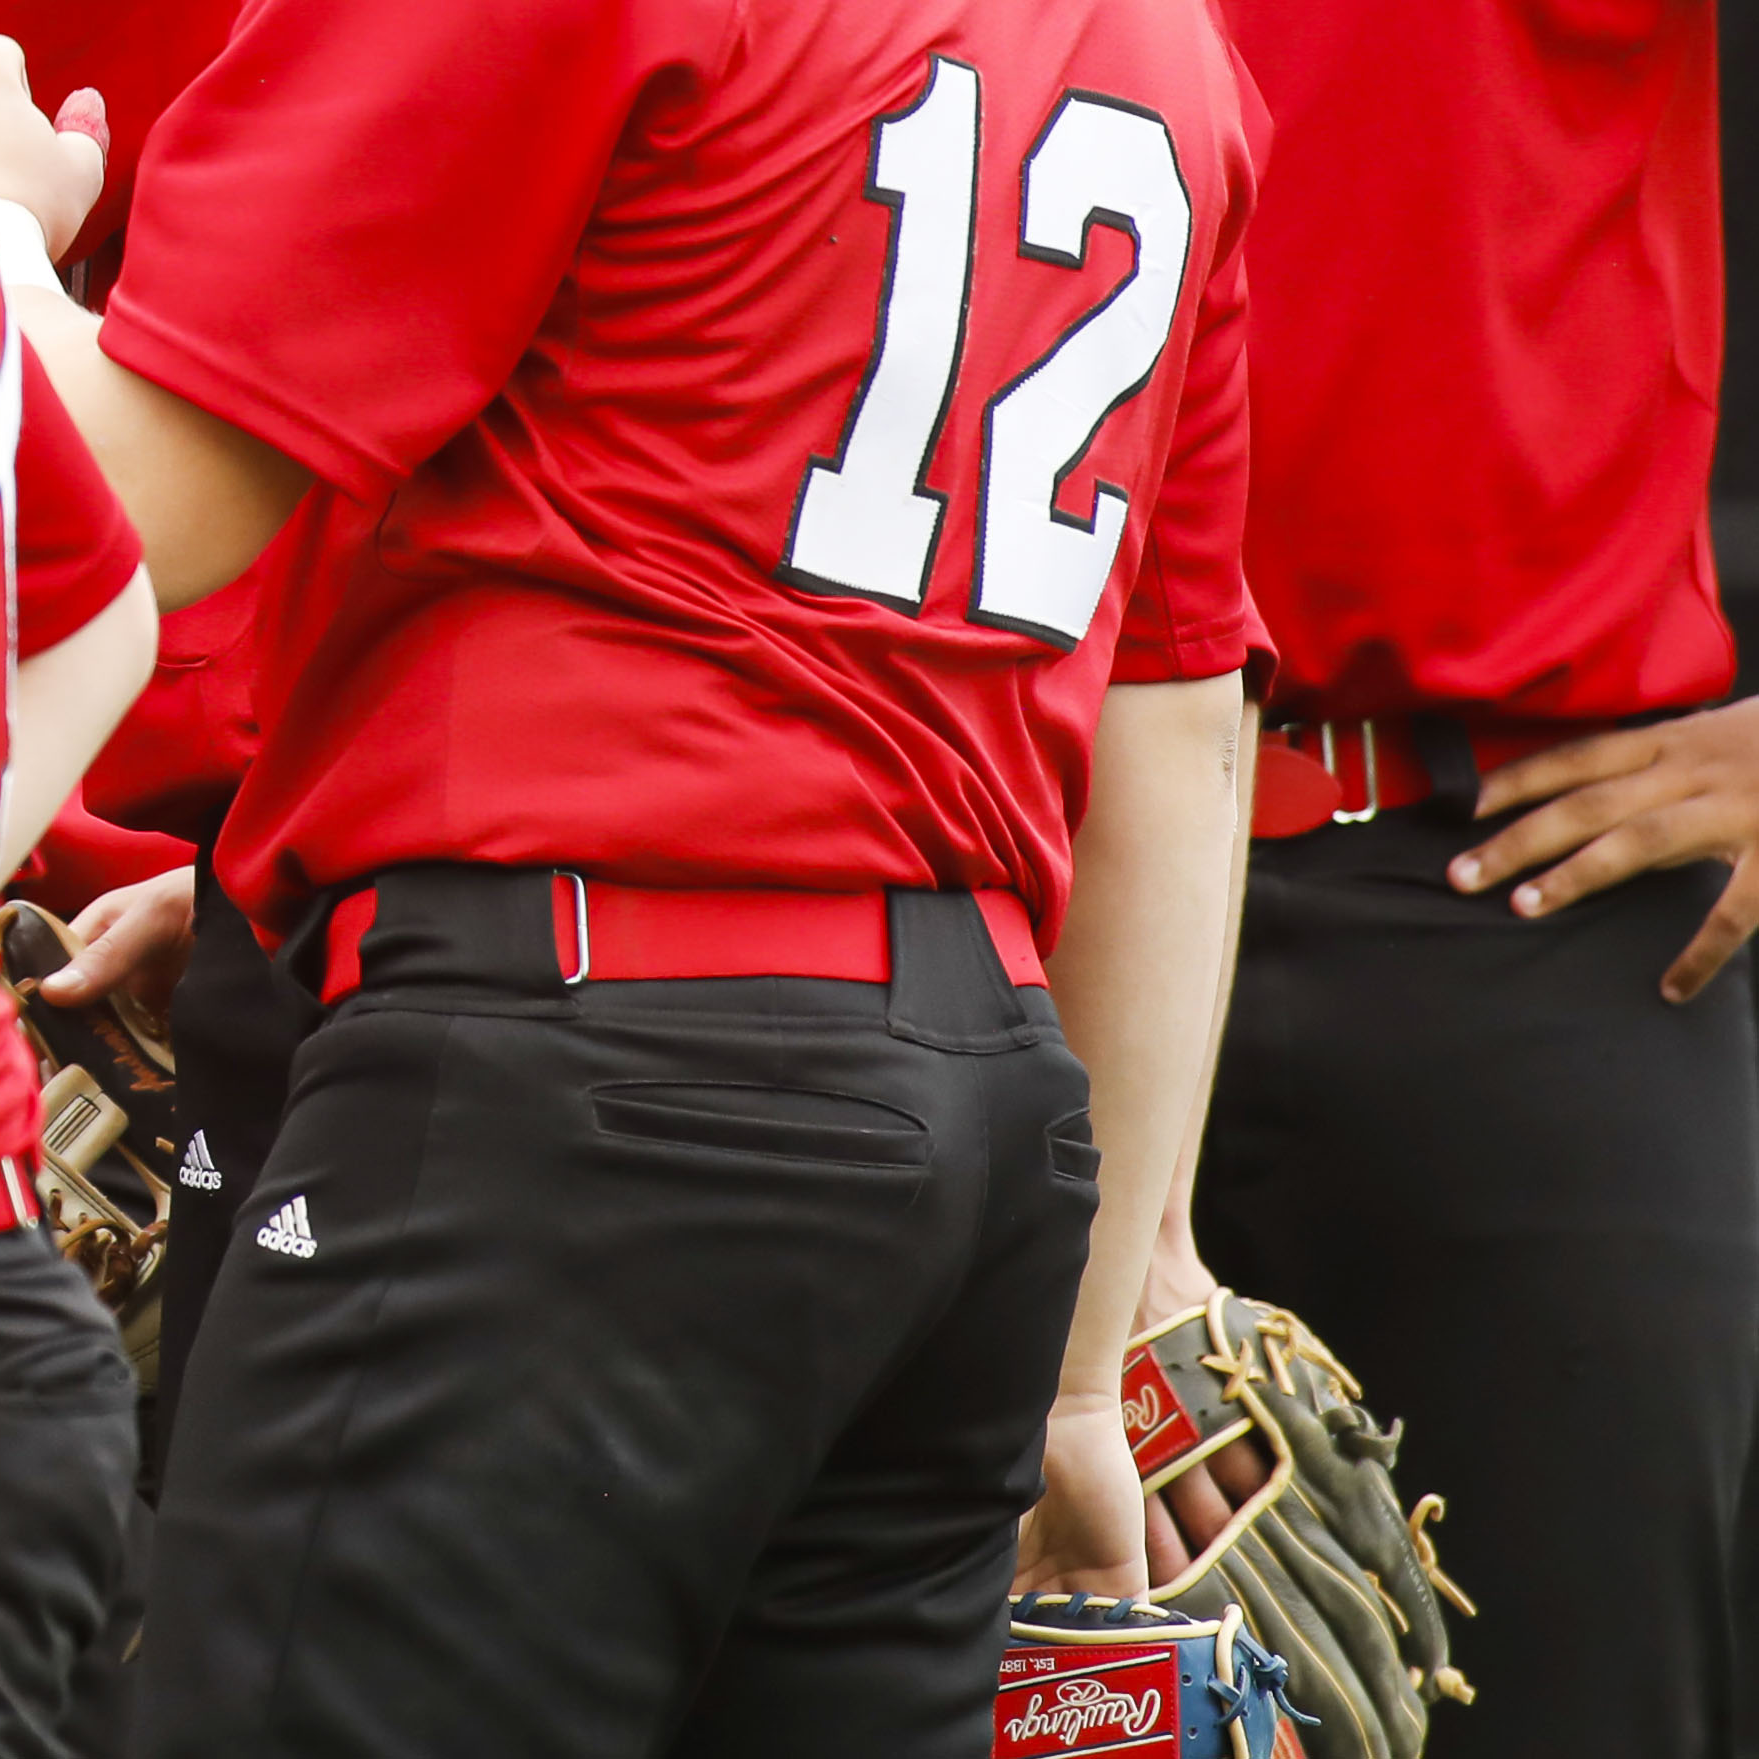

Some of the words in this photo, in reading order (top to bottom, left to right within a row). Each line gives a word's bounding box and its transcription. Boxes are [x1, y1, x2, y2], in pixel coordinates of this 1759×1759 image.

[772, 51, 1193, 654] 12
[179, 1165, 222, 1190] adidas
[257, 1226, 318, 1259] adidas
[1003, 1687, 1162, 1746] Rawlings
